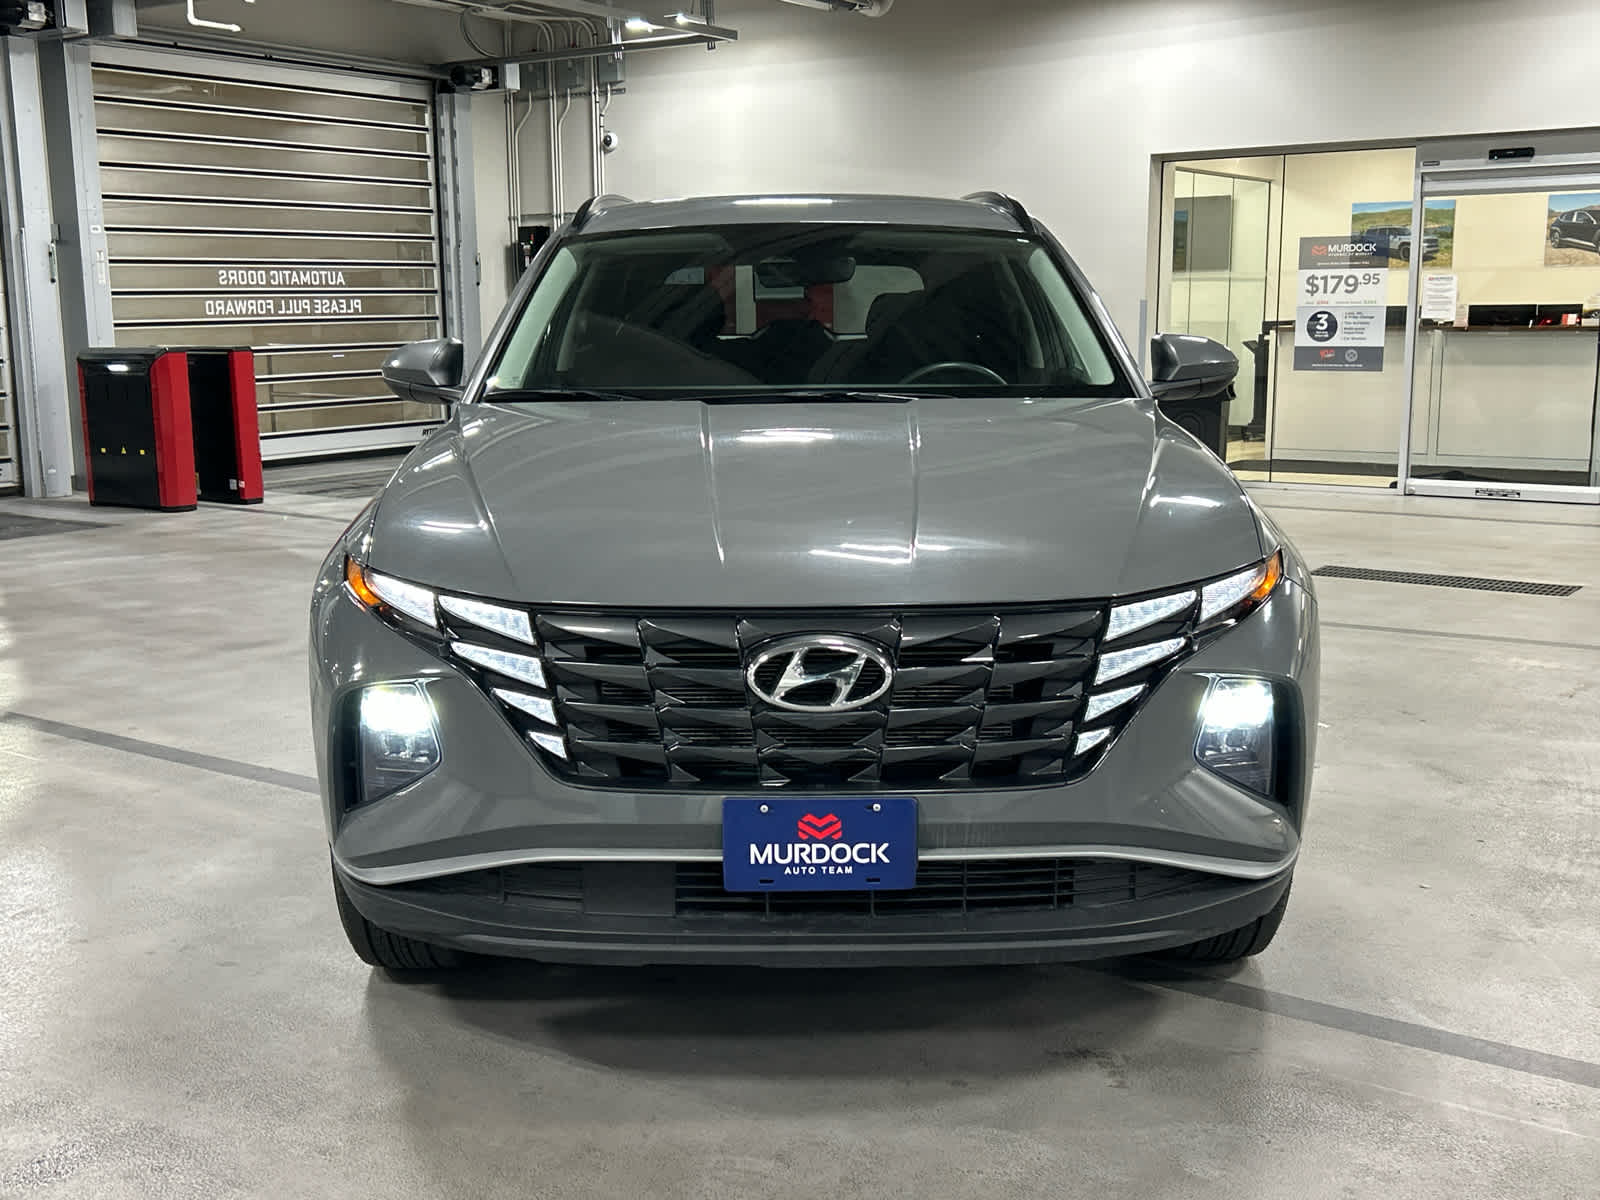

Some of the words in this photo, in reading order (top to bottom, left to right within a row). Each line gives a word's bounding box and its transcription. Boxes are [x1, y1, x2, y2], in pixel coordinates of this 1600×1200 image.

[1328, 243, 1376, 253] MURDOCK
[1316, 313, 1329, 331] 3
[750, 843, 890, 865] MURDOCK
[784, 866, 816, 875] AUTO
[822, 865, 853, 874] TEAM
